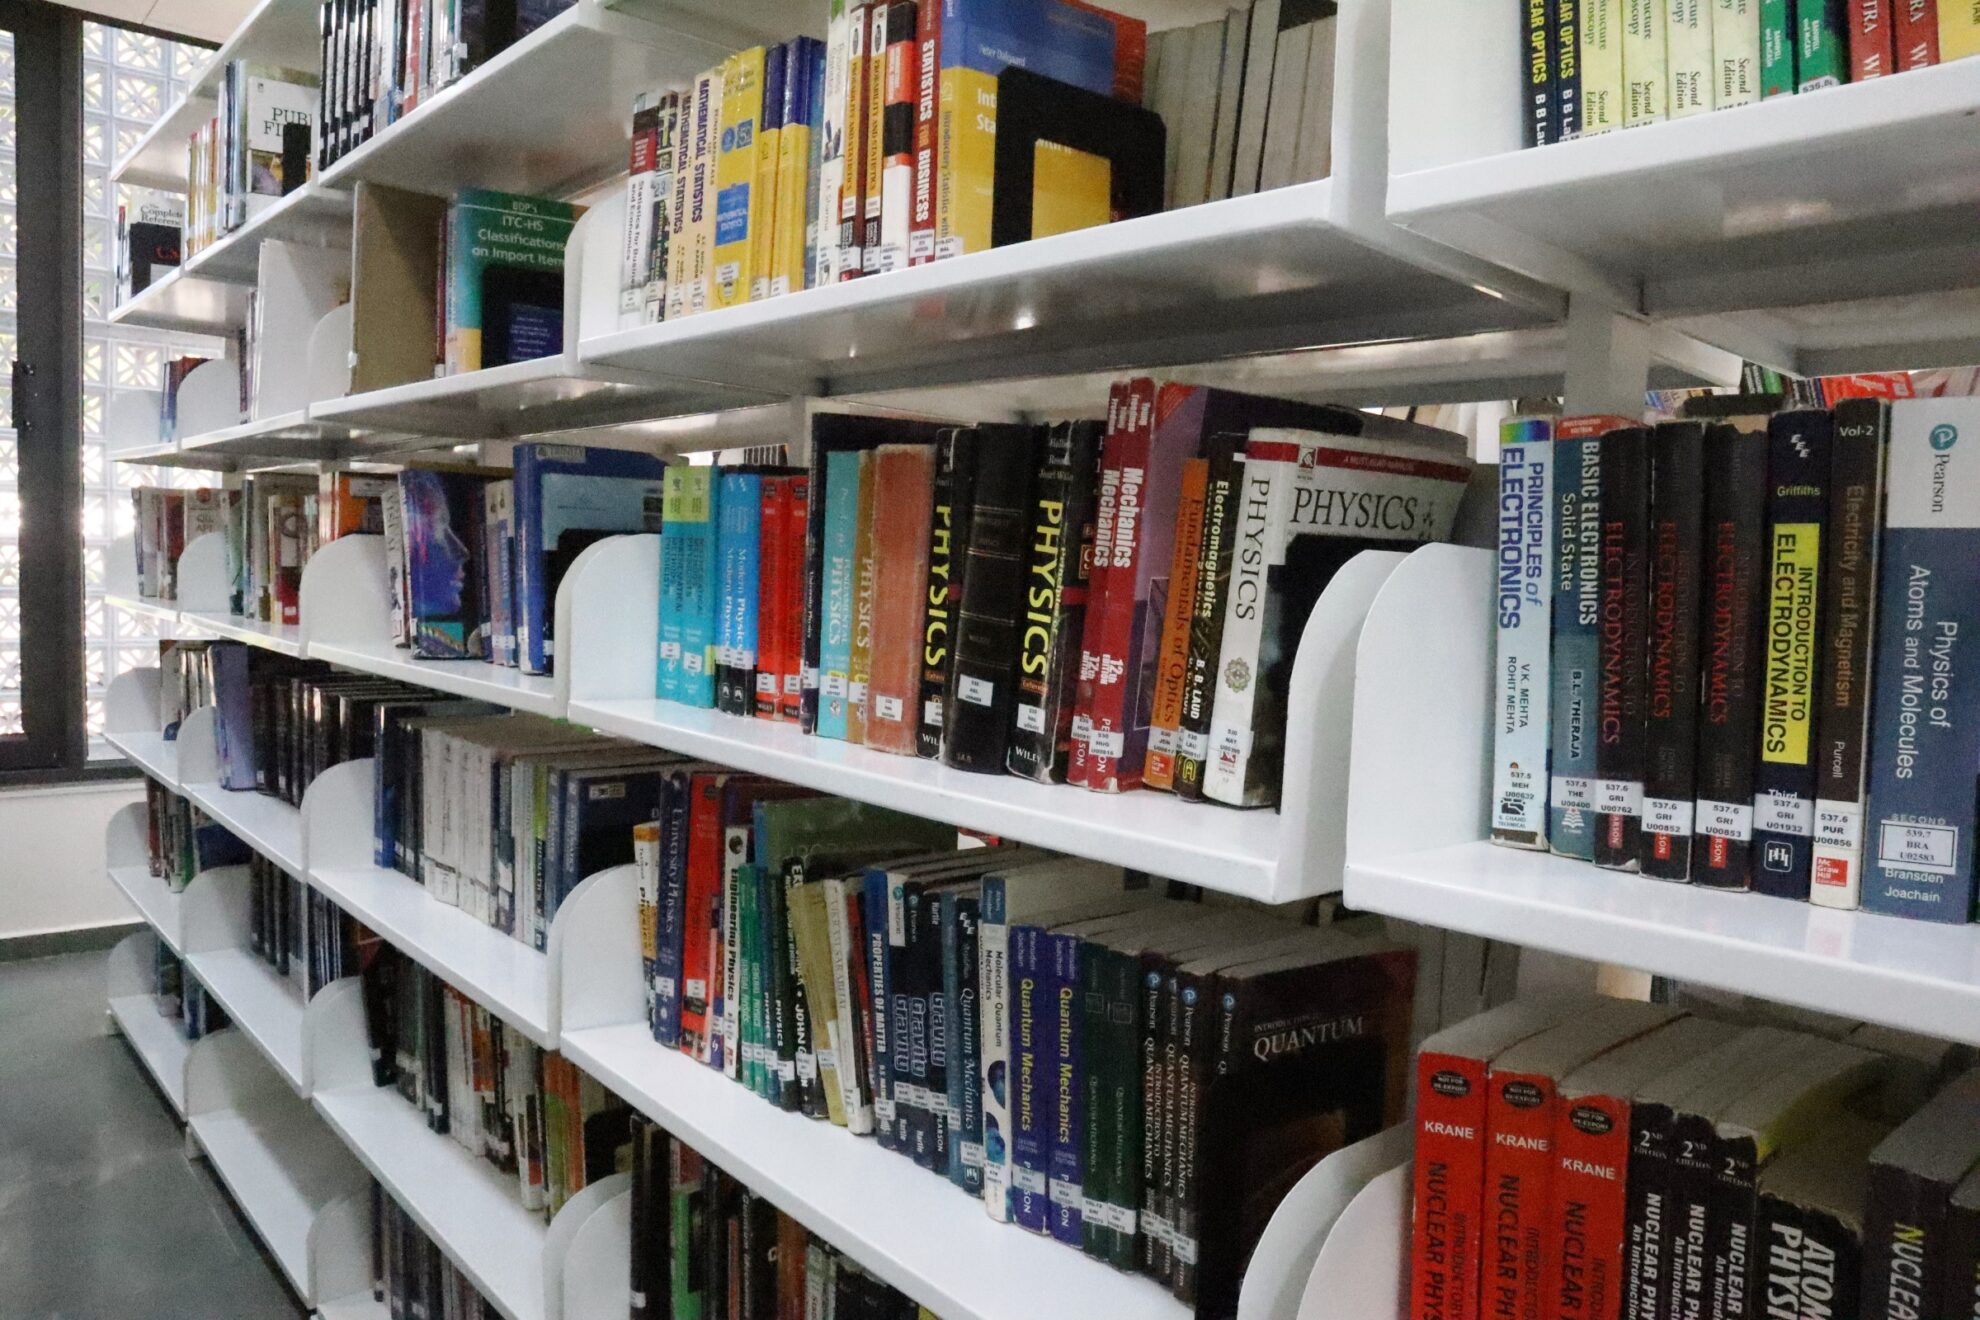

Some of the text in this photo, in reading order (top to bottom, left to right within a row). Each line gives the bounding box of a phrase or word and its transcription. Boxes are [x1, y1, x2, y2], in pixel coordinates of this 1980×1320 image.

[1531, 31, 1547, 118] OPTICS B B
[1559, 27, 1574, 114] OPTICS B B
[1675, 72, 1685, 109] Edition
[1689, 71, 1702, 106] Second
[1723, 59, 1735, 97] Edition
[1738, 58, 1751, 94] Second
[1586, 91, 1595, 126] Edition
[1598, 91, 1609, 124] Second
[1631, 82, 1641, 118] Edition
[1643, 81, 1654, 114] Second
[692, 78, 710, 224] MATHEMATICAL STATISTICS
[916, 39, 935, 222] STATISTICS BUSINESS
[673, 96, 692, 235] MATHEMATICAL STATISTICS
[501, 216, 544, 232] ITC-HS
[492, 247, 536, 265] Import
[1840, 425, 1874, 437] Vol-2
[1581, 441, 1600, 498] BASIC
[1777, 485, 1821, 497] Griffiths
[1931, 453, 1950, 514] Pearson
[1093, 469, 1121, 567] Mechanics
[1113, 467, 1144, 568] Mechanics
[1289, 486, 1419, 532] PHYSICS
[1202, 480, 1230, 618] Electromagnetics
[1235, 476, 1271, 621] PHYSICS
[1499, 447, 1525, 630] ELECTRONICS
[1525, 462, 1545, 607] PRINCIPLES of
[1560, 492, 1577, 592] Solid State
[925, 505, 951, 665] PHYSICS
[1022, 500, 1064, 675] PHYSICS
[1175, 498, 1205, 632] Fundamentals
[1578, 502, 1600, 626] ELECTRONICS
[735, 548, 746, 650] Modern Physics
[829, 556, 844, 645] PHYSICS
[857, 557, 873, 648] PHYSICS
[1834, 485, 1865, 707] Electricity and Magnetism
[1602, 520, 1624, 745] ELECTRODYNAMICS
[1766, 534, 1796, 753] ELECTRODYNAMICS
[1791, 567, 1813, 721] INTRODUCTION TO
[1163, 663, 1184, 723] Optics
[1505, 656, 1518, 736] ROHIT MEHTA
[1895, 565, 1931, 780] Atoms and Molecules
[1929, 621, 1958, 728] Physics of
[1190, 689, 1203, 720] LAUD
[1519, 687, 1530, 729] MEHTA
[1570, 699, 1583, 760] THERAJA
[1015, 745, 1041, 764] WILEY
[1831, 741, 1846, 778] Purcell
[1511, 781, 1530, 790] MEH
[1568, 790, 1584, 798] THE
[1601, 804, 1633, 815] U00762
[1608, 794, 1624, 803] GRI
[1652, 801, 1678, 811] 537.6
[1713, 804, 1740, 815] 537.6
[1773, 800, 1800, 809] 537.6
[1646, 823, 1681, 833] U00852
[1655, 812, 1673, 821] GRI
[1705, 826, 1742, 838] U00853
[1716, 816, 1733, 825] GRI
[1766, 821, 1803, 833] U01932
[1776, 811, 1795, 820] GRI
[1820, 813, 1849, 823] 537.6
[1823, 825, 1844, 835] PUR
[1906, 829, 1932, 839] 539.7
[1813, 836, 1852, 848] U00856
[1907, 841, 1929, 850] BRA
[1817, 866, 1840, 874] Graw
[1884, 886, 1941, 903] Joachain
[1885, 867, 1944, 884] Bransden
[727, 948, 738, 1002] Physics
[872, 933, 884, 995] PROPERTIES
[984, 949, 994, 1001] Mechanics
[775, 999, 784, 1047] PHYSICS
[795, 1003, 806, 1044] JOHN
[960, 987, 976, 1055] Quantum
[994, 951, 1004, 1049] Molecular Quantum
[875, 1012, 887, 1053] MATTER
[911, 997, 927, 1078] Gravity
[930, 992, 946, 1067] Gravity
[1183, 1006, 1194, 1047] Pearson
[1222, 1012, 1233, 1053] Pearson
[1252, 1016, 1364, 1063] QUANTUM
[1020, 978, 1034, 1132] Quantum Mechanics
[1059, 986, 1073, 1145] Quantum Mechanics
[1164, 1043, 1175, 1110] QUANTUM
[963, 1059, 980, 1131] Mechanics
[1144, 1037, 1155, 1180] QUANTUM MECHANICS
[1163, 1112, 1174, 1188] MECHANICS
[1177, 1054, 1190, 1200] QUANTUM MECHANICS
[1424, 1120, 1475, 1140] KRANE
[1495, 1132, 1549, 1152] KRANE
[1562, 1157, 1617, 1181] KRANE
[1424, 1161, 1448, 1265] NUCLEAR
[1496, 1173, 1521, 1282] NUCLEAR
[1631, 1224, 1643, 1243] An
[1643, 1192, 1663, 1280] NUCLEAR
[1561, 1201, 1587, 1311] NUCLEAR
[1672, 1236, 1686, 1256] An
[1685, 1203, 1706, 1294] NUCLEAR
[1714, 1254, 1727, 1274] An
[1727, 1223, 1748, 1314] NUCLEAR
